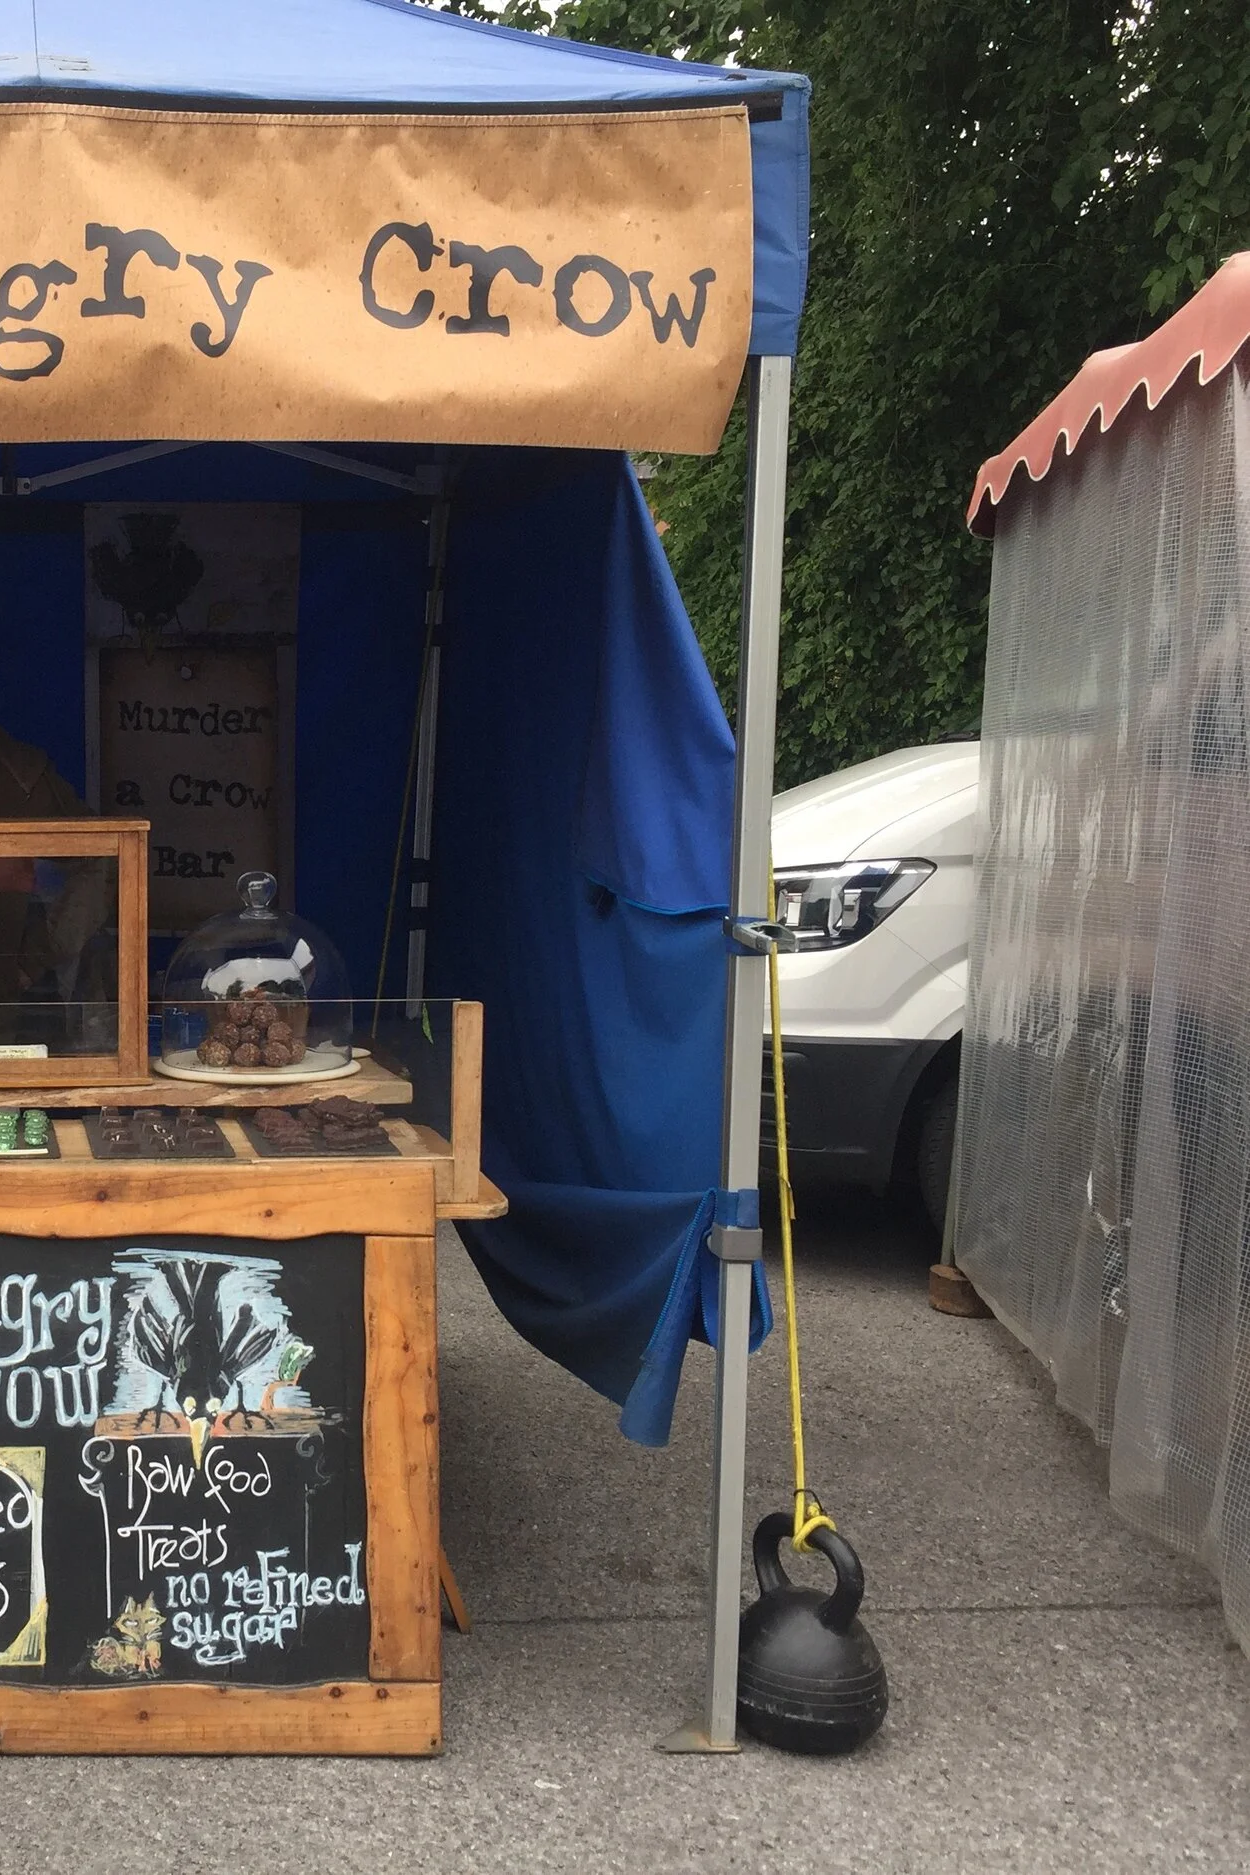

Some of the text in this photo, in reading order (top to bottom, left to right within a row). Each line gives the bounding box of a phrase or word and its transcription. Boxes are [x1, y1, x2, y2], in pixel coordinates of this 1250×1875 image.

[360, 221, 717, 348] Crow
[119, 701, 273, 736] Murder
[116, 773, 273, 810] a Crow
[152, 846, 234, 878] Bar
[204, 1445, 272, 1514] food
[117, 1518, 227, 1581] Treats
[165, 1572, 210, 1608] no
[170, 1606, 297, 1666] sugar
